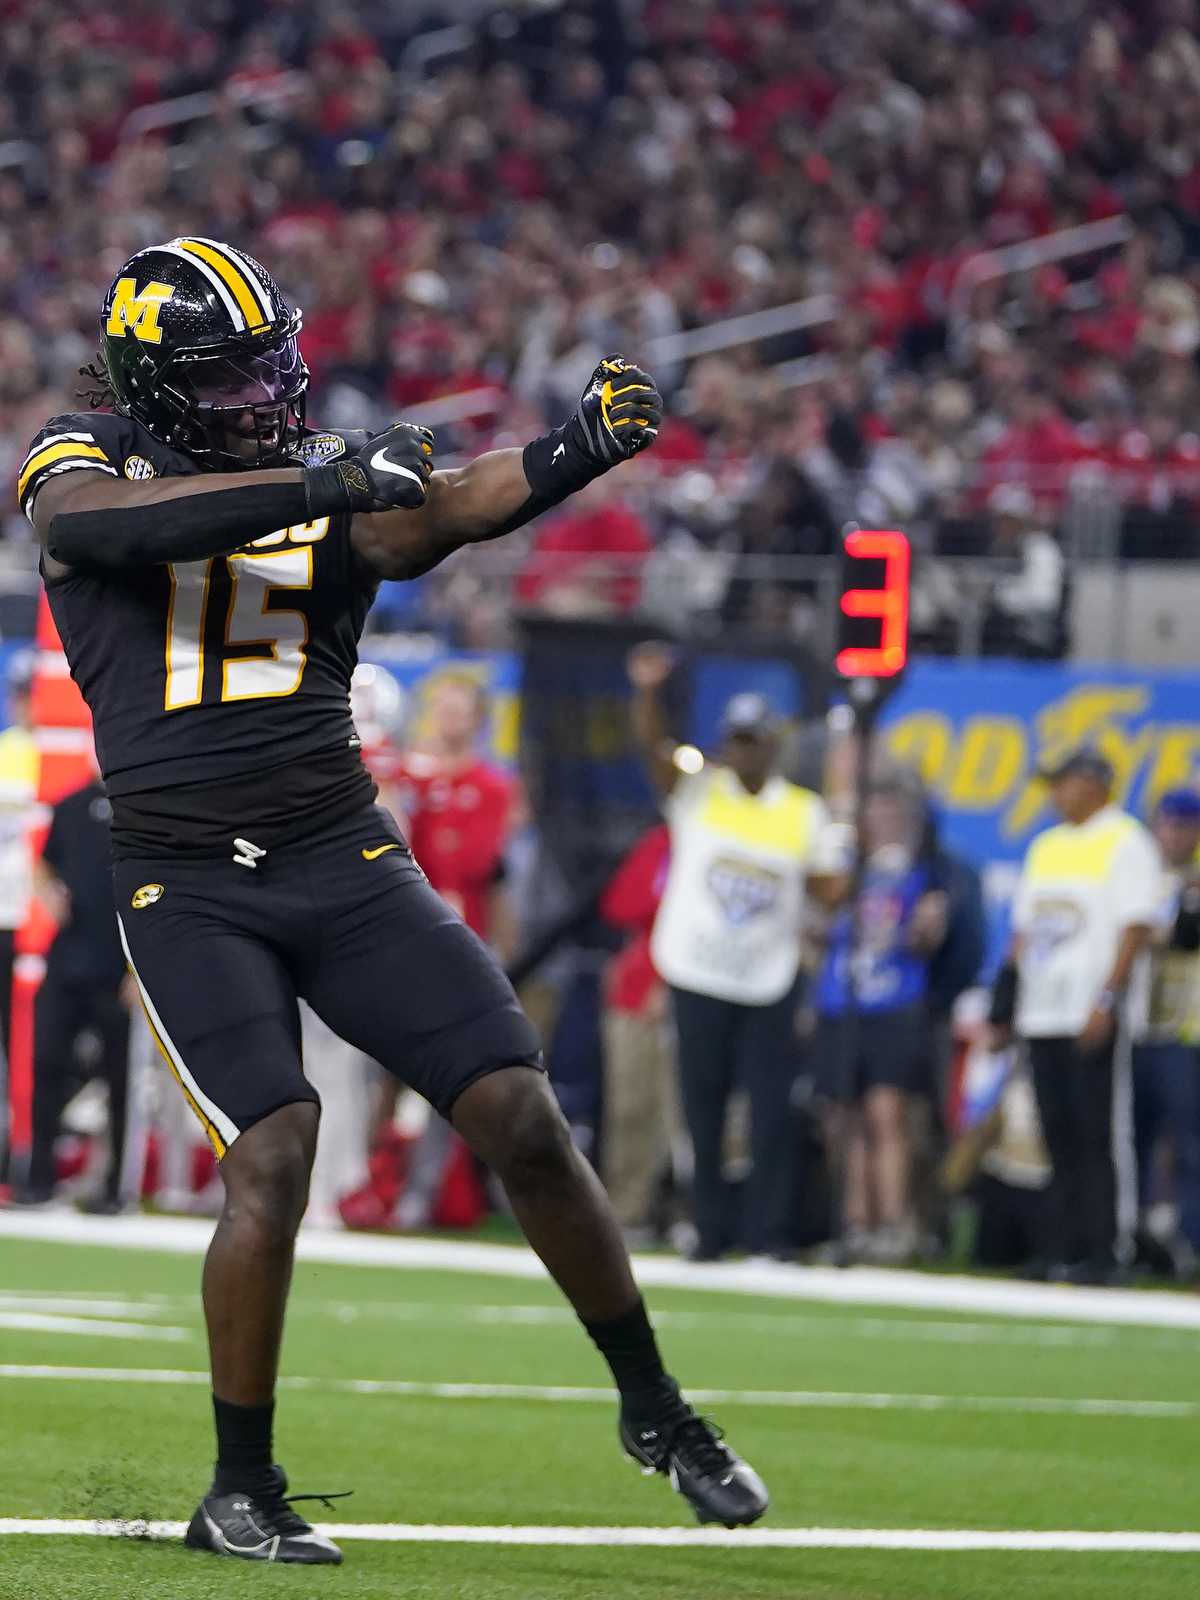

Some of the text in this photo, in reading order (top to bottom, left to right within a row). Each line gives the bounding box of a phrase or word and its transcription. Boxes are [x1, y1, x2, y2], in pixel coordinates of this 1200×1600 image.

[107, 277, 176, 344] M
[127, 458, 151, 480] SEC
[165, 545, 313, 711] 15
[836, 531, 910, 677] 3
